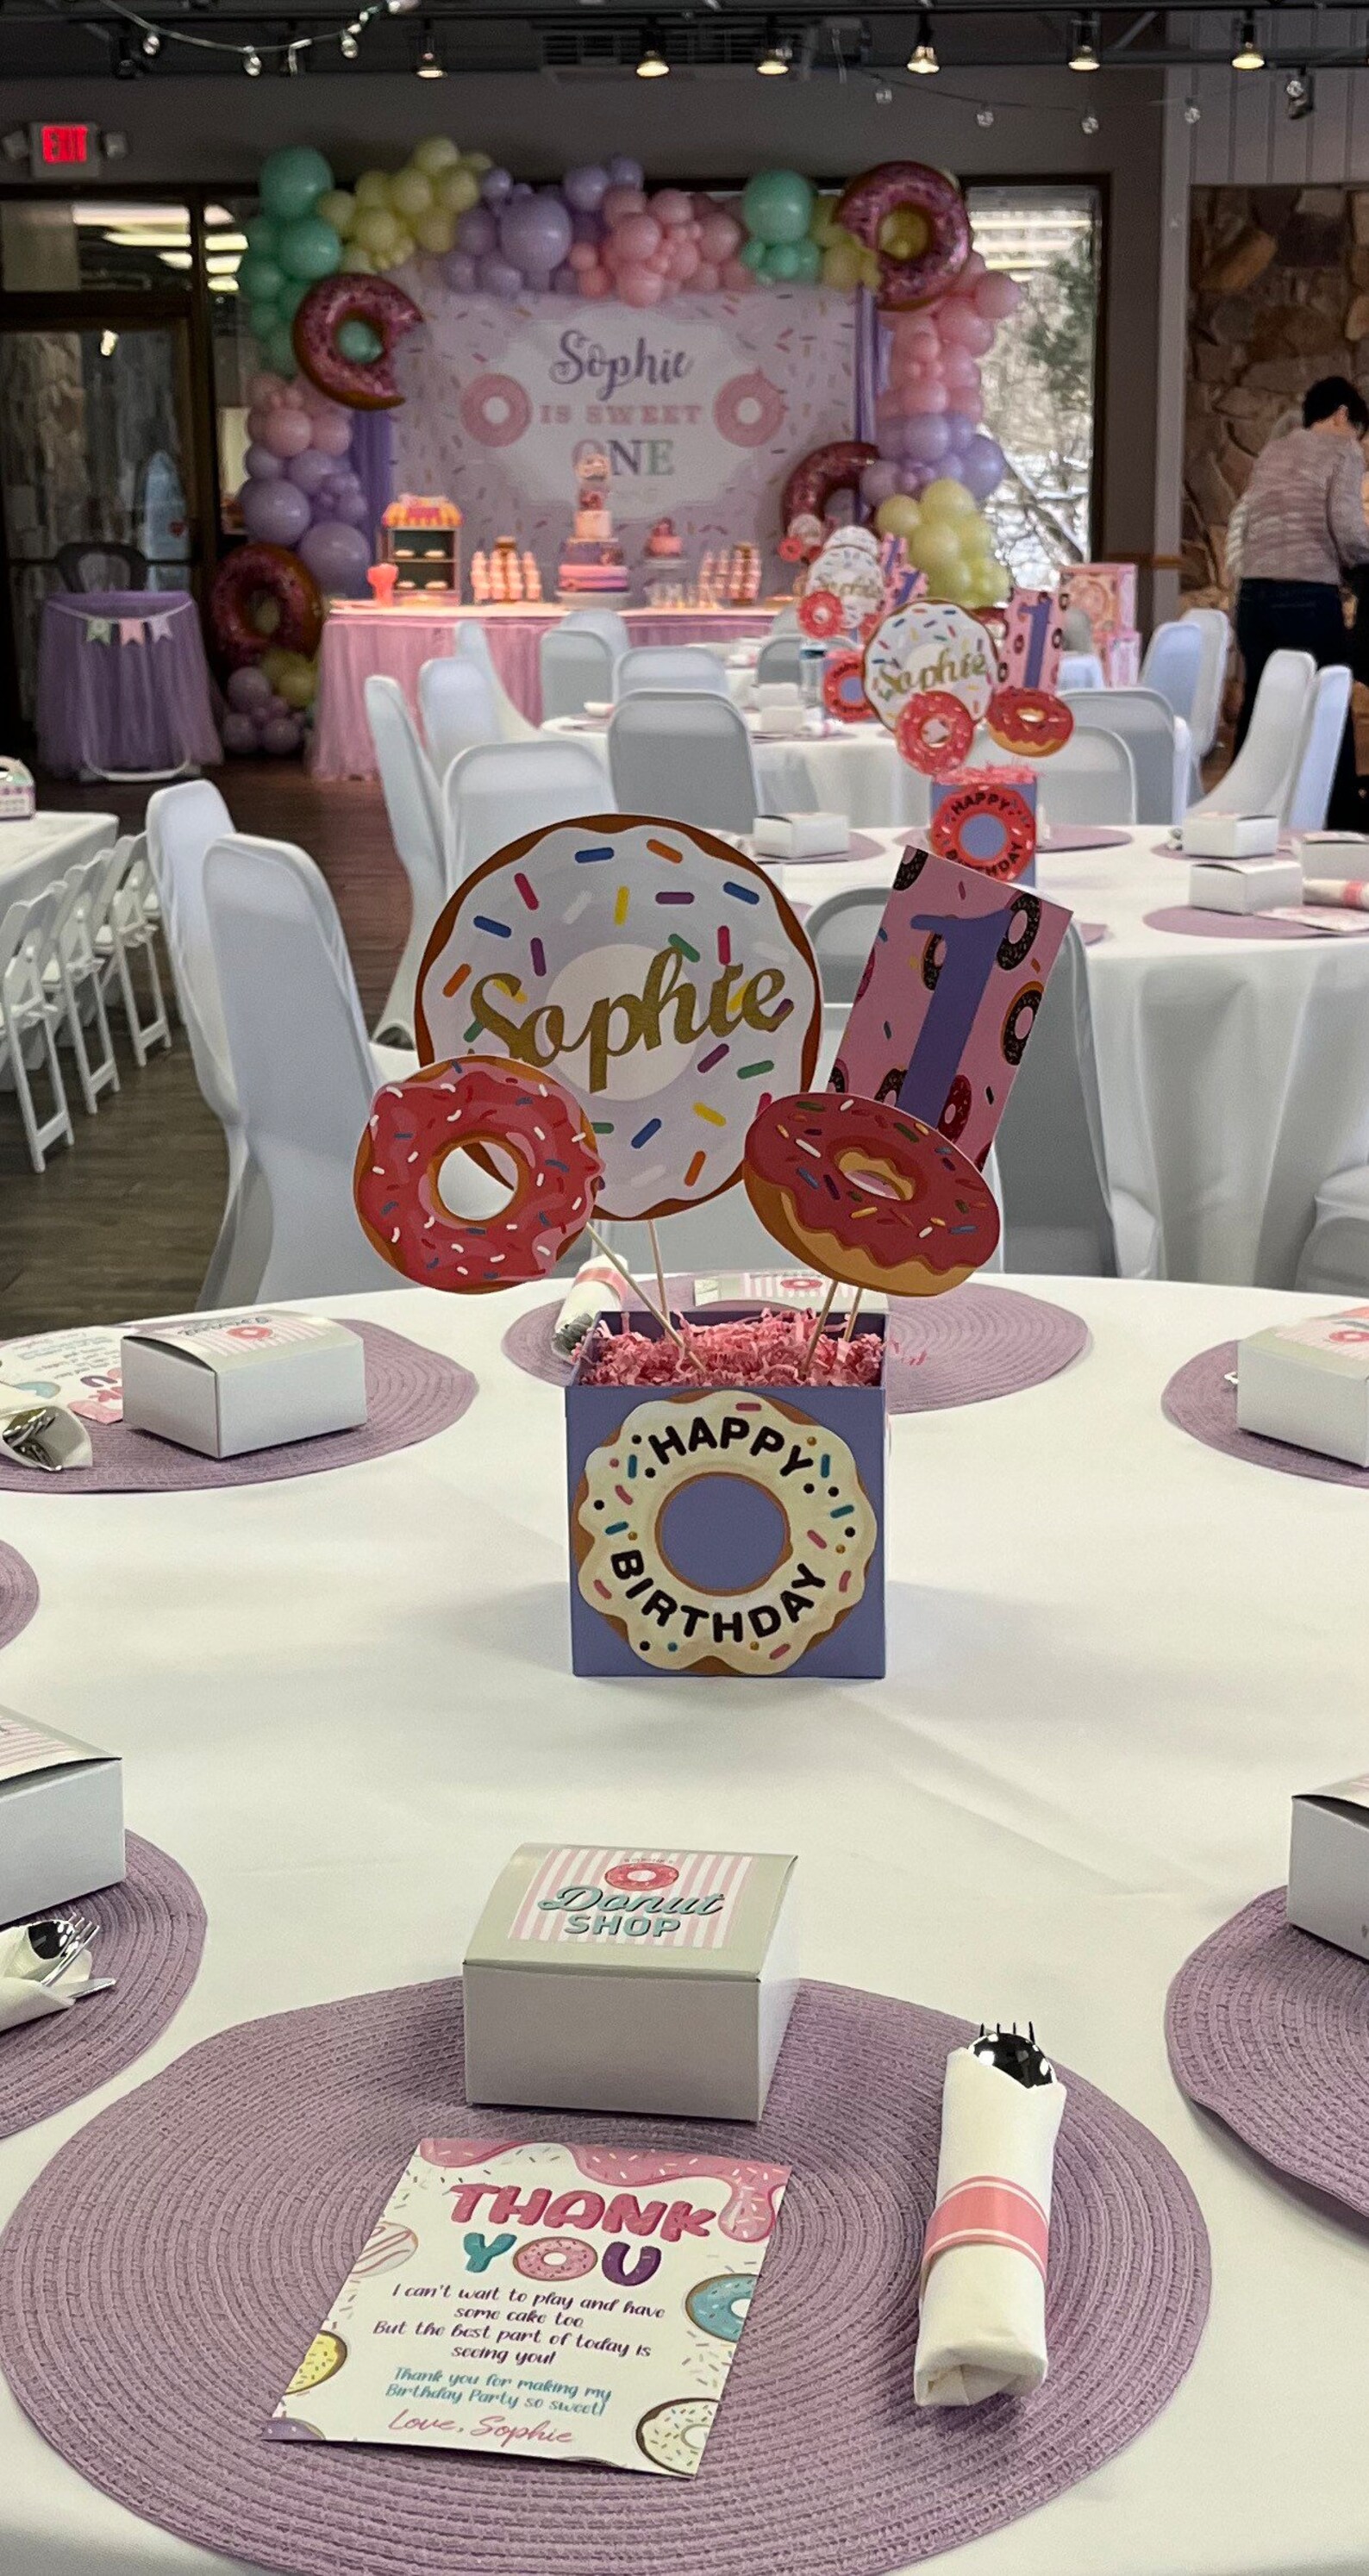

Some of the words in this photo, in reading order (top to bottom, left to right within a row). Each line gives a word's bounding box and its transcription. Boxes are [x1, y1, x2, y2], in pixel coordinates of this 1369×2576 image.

[548, 329, 693, 401] Sophie
[539, 404, 571, 424] IS
[585, 404, 703, 425] SWEET
[878, 647, 987, 697] Sophie
[949, 791, 1010, 815] HAPPY
[945, 841, 1023, 877] BHDAY
[468, 946, 795, 1094] Sophie
[896, 910, 1015, 1129] 1
[647, 1416, 814, 1478] HAPPY
[610, 1549, 826, 1643] BIRTHDAY
[538, 1885, 725, 1916] Donut
[564, 1915, 681, 1938] SHOP
[450, 2183, 716, 2242] THANK
[463, 2232, 662, 2286] YOU
[392, 2284, 402, 2297] I
[404, 2285, 452, 2298] can't
[458, 2286, 500, 2301] wait
[509, 2288, 528, 2303] to
[532, 2292, 574, 2310] play
[580, 2298, 620, 2312] and
[623, 2300, 666, 2318] have
[453, 2307, 500, 2320] some
[506, 2310, 547, 2324] cake
[555, 2311, 584, 2328] too
[372, 2320, 407, 2335] But
[415, 2321, 446, 2336] the
[450, 2323, 491, 2340] best
[496, 2329, 541, 2343] part
[549, 2332, 572, 2346] of
[575, 2334, 630, 2358] today
[635, 2343, 652, 2357] is
[452, 2345, 509, 2365] seeing
[515, 2350, 557, 2366] you!
[385, 2383, 464, 2404] Birthday
[468, 2389, 520, 2409] Party
[524, 2398, 544, 2408] so
[549, 2399, 607, 2417] sweet!
[394, 2367, 443, 2383] Thank
[448, 2373, 479, 2387] you
[485, 2373, 512, 2387] for
[517, 2379, 579, 2398] making
[584, 2386, 612, 2403] my
[388, 2409, 465, 2433] Love,
[470, 2416, 572, 2448] Sophie
